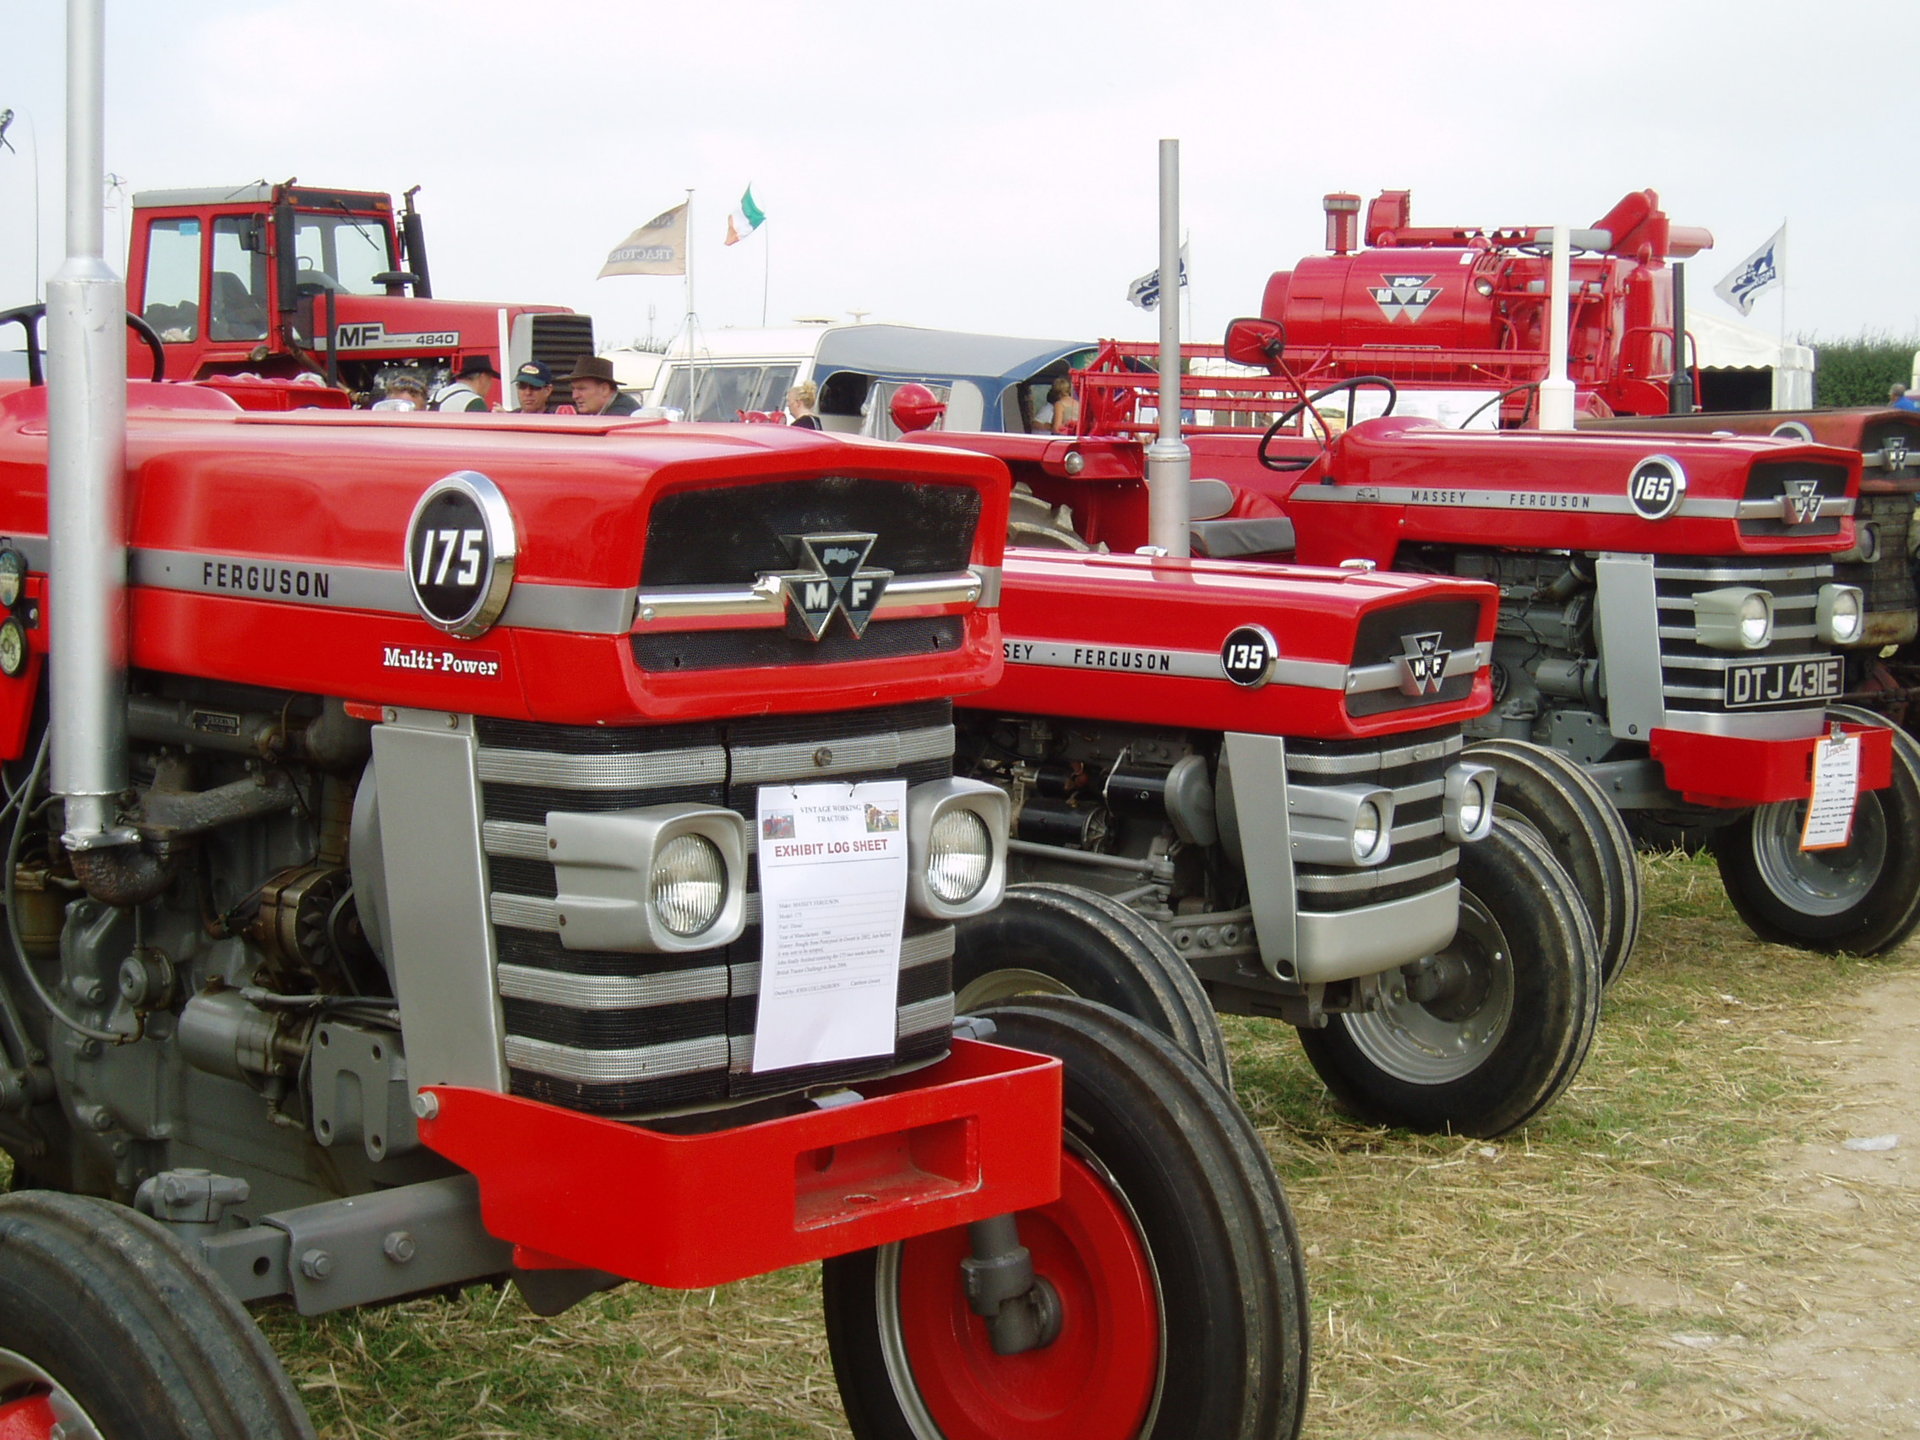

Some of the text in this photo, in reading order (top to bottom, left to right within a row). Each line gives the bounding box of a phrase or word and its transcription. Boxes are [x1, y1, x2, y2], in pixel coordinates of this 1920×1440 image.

[339, 325, 455, 347] MF 4840
[1411, 490, 1591, 508] MASSEY FERGUSON
[1634, 476, 1672, 501] 165
[418, 529, 484, 586] 175
[203, 561, 329, 598] FERGUSON
[383, 647, 498, 676] Multi-Power
[1003, 643, 1170, 671] SEY FERGUSON
[1227, 644, 1264, 669] 135
[800, 804, 861, 813] VINTAGE WORKING
[817, 815, 849, 823] TRACTORS
[775, 839, 888, 857] EXHIBIT LOG SHEET
